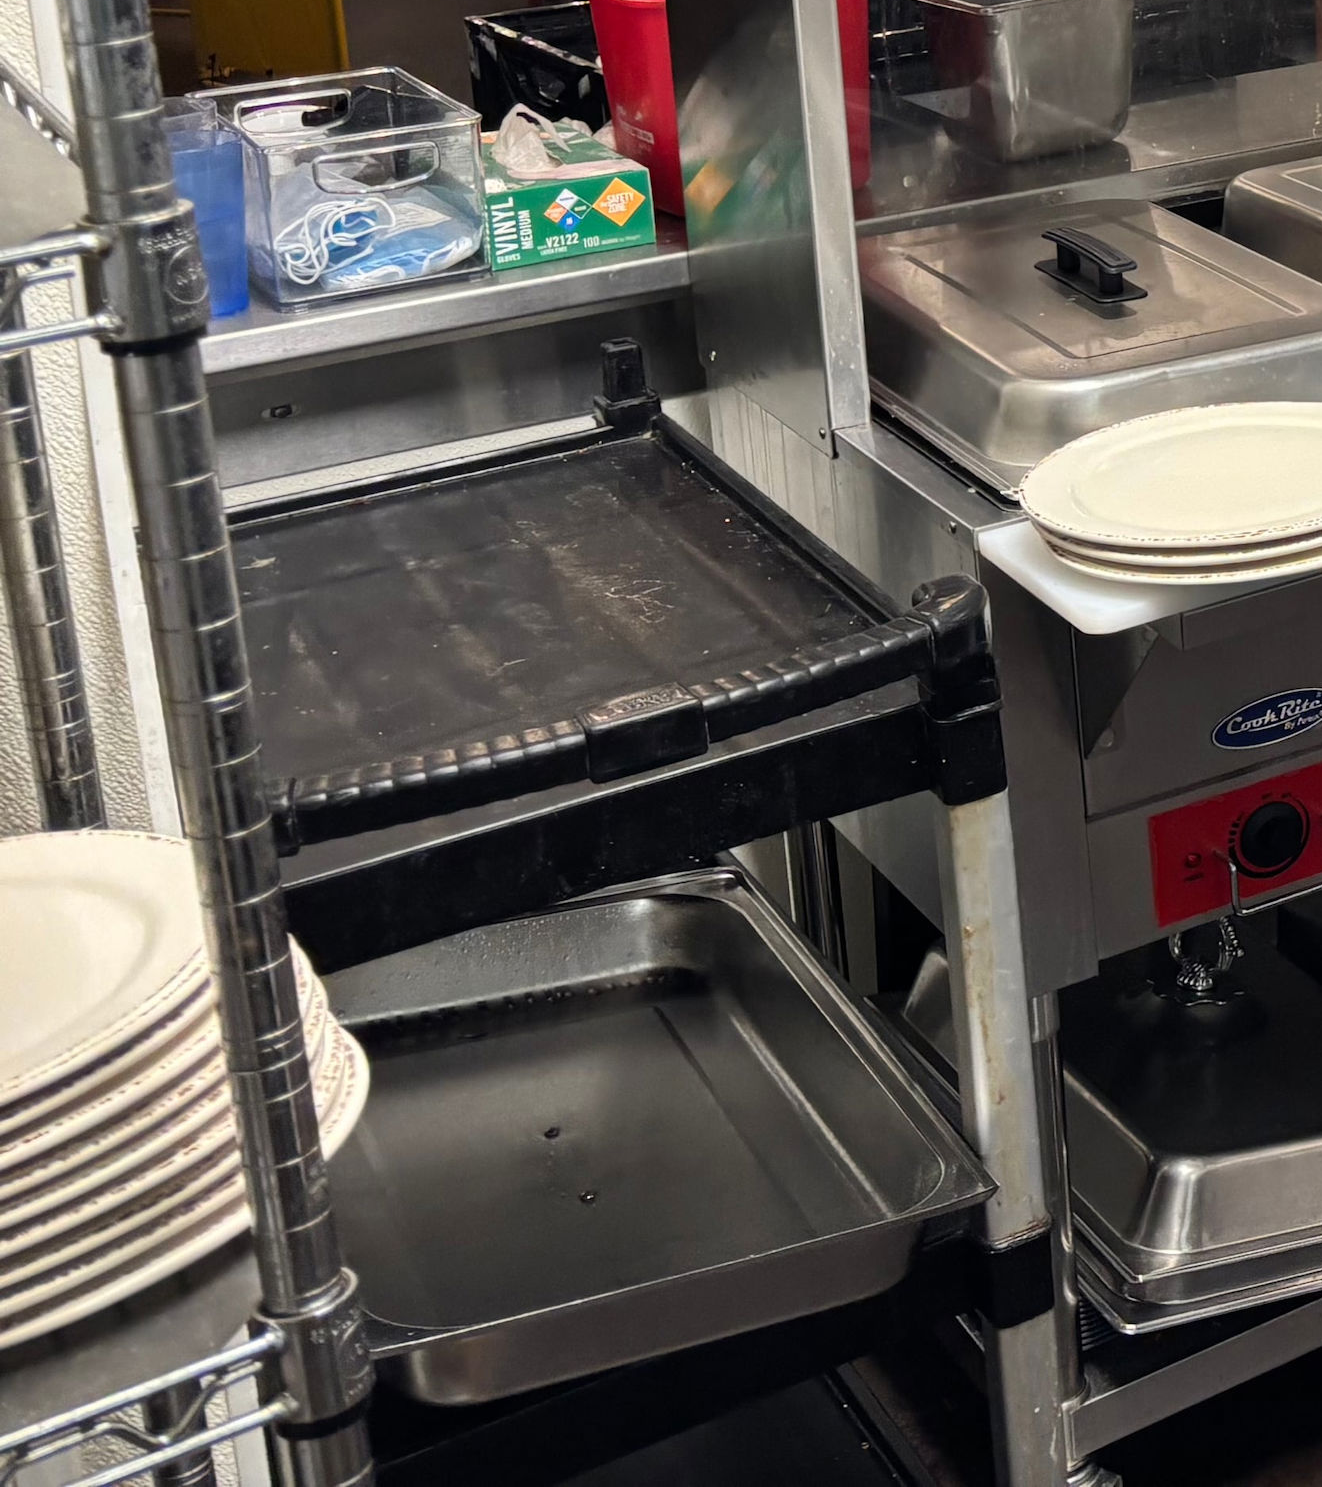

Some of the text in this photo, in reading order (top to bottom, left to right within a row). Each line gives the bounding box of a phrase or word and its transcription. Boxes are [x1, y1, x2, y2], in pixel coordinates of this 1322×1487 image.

[606, 192, 635, 203] SAFETY
[491, 196, 519, 256] VINYL
[517, 209, 534, 250] MEDIUM
[546, 232, 579, 249] V2122
[583, 236, 600, 248] 100
